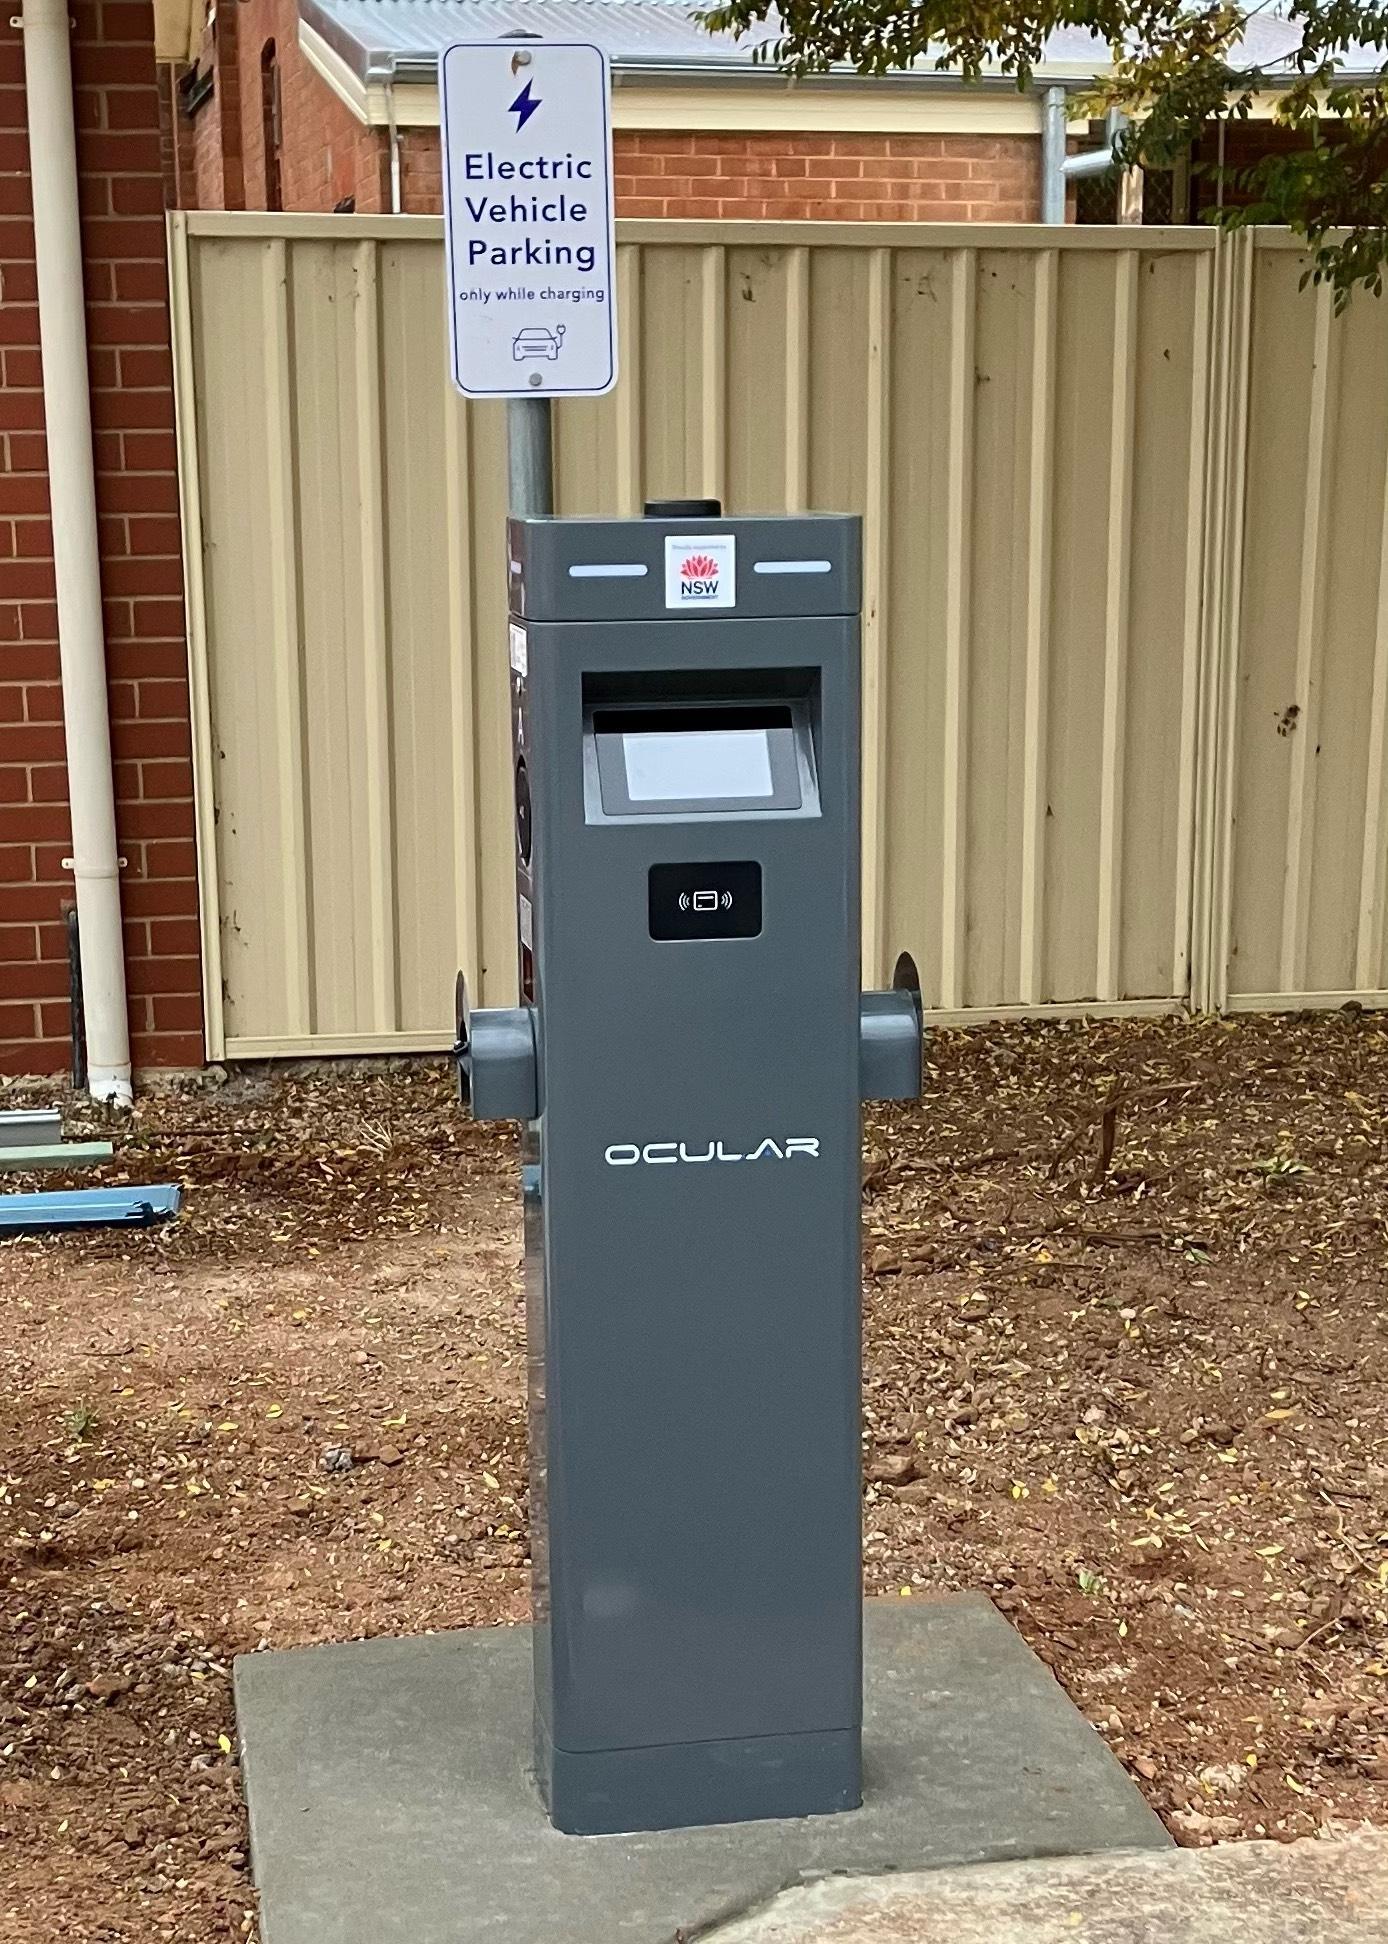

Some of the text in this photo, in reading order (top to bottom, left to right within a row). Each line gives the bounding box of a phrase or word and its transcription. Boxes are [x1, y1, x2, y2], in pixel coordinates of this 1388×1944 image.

[465, 151, 592, 180] Electric
[464, 194, 588, 223] Vehicle
[468, 237, 595, 272] Parking
[459, 286, 605, 304] only while charging
[681, 580, 719, 595] NSW
[604, 1137, 820, 1166] OCULAR
